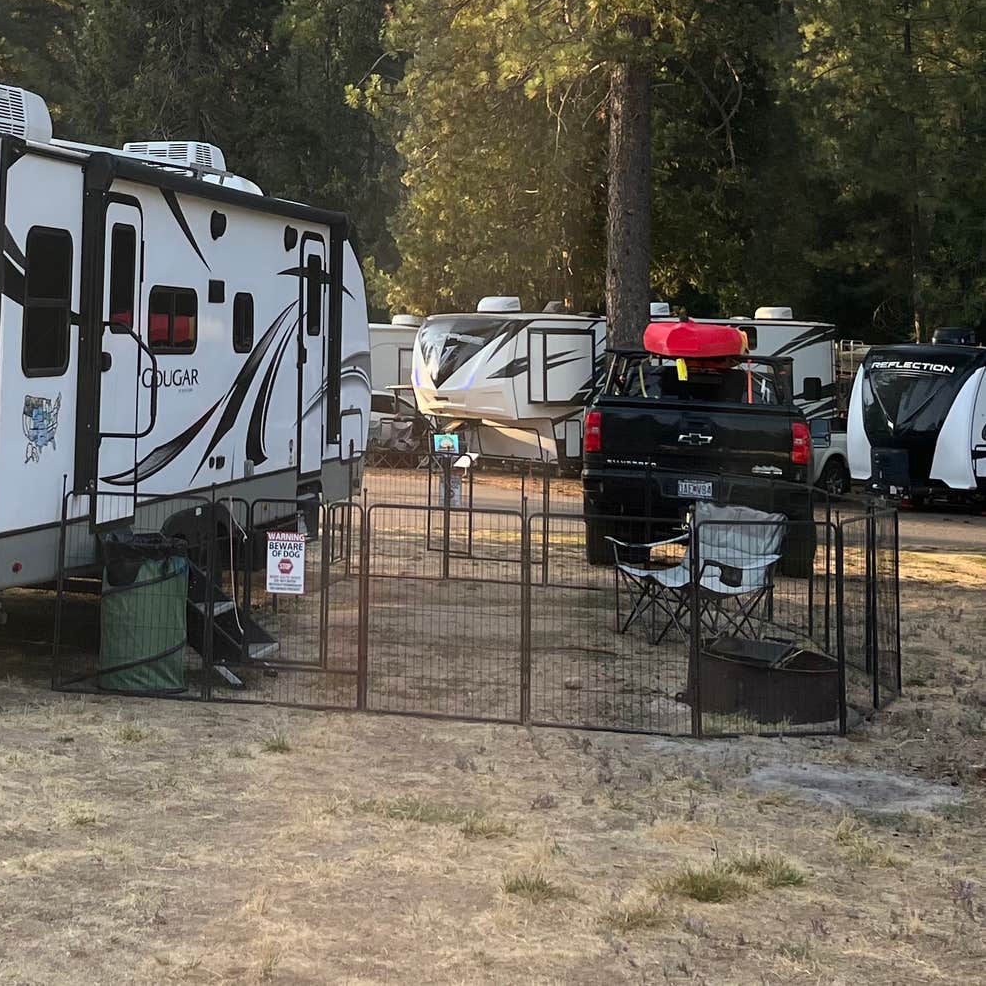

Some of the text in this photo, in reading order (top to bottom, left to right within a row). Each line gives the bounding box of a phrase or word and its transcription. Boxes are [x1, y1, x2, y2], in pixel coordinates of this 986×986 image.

[871, 361, 955, 373] REFLECTION
[267, 532, 305, 542] WARNING
[269, 542, 303, 551] BEWARE
